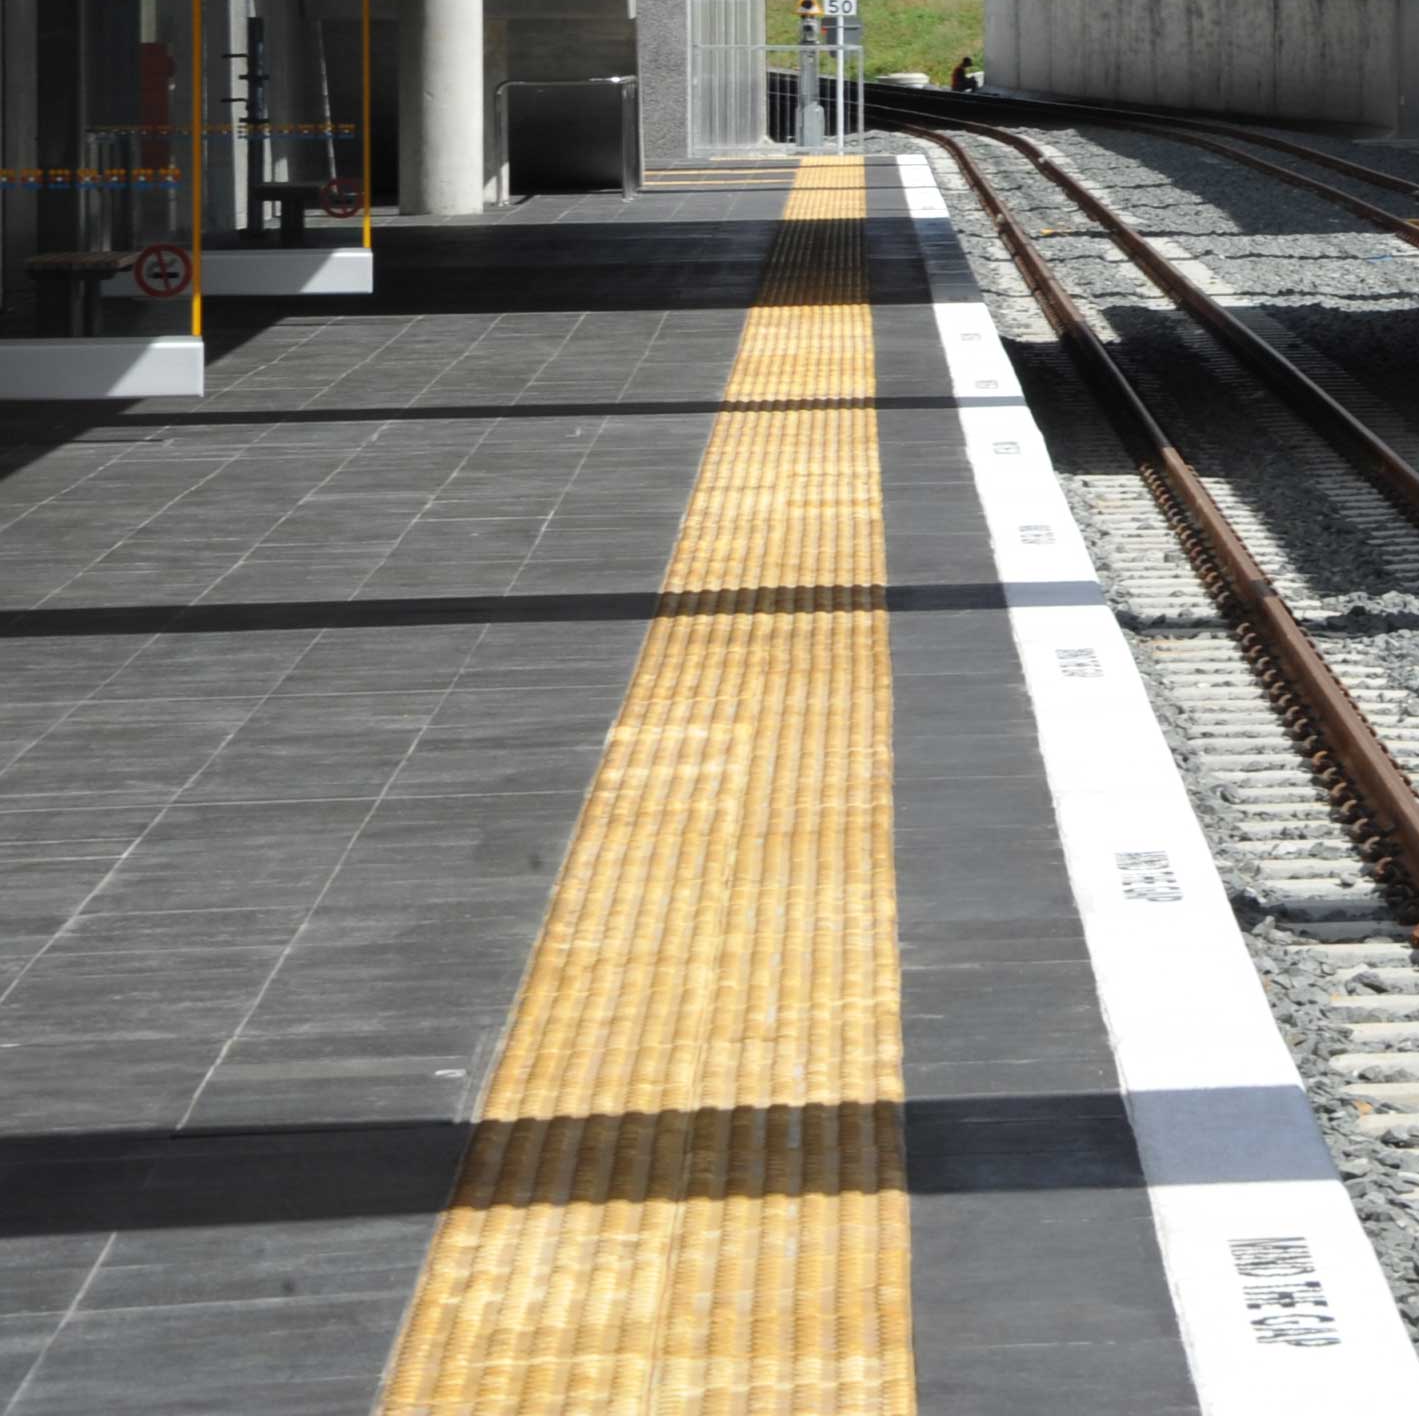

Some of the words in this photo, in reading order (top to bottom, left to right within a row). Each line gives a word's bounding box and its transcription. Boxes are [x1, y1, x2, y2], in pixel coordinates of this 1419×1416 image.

[828, 0, 853, 14] 50
[1227, 1236, 1317, 1277] MIND
[1242, 1280, 1328, 1309] THE
[1250, 1313, 1342, 1347] GAP
